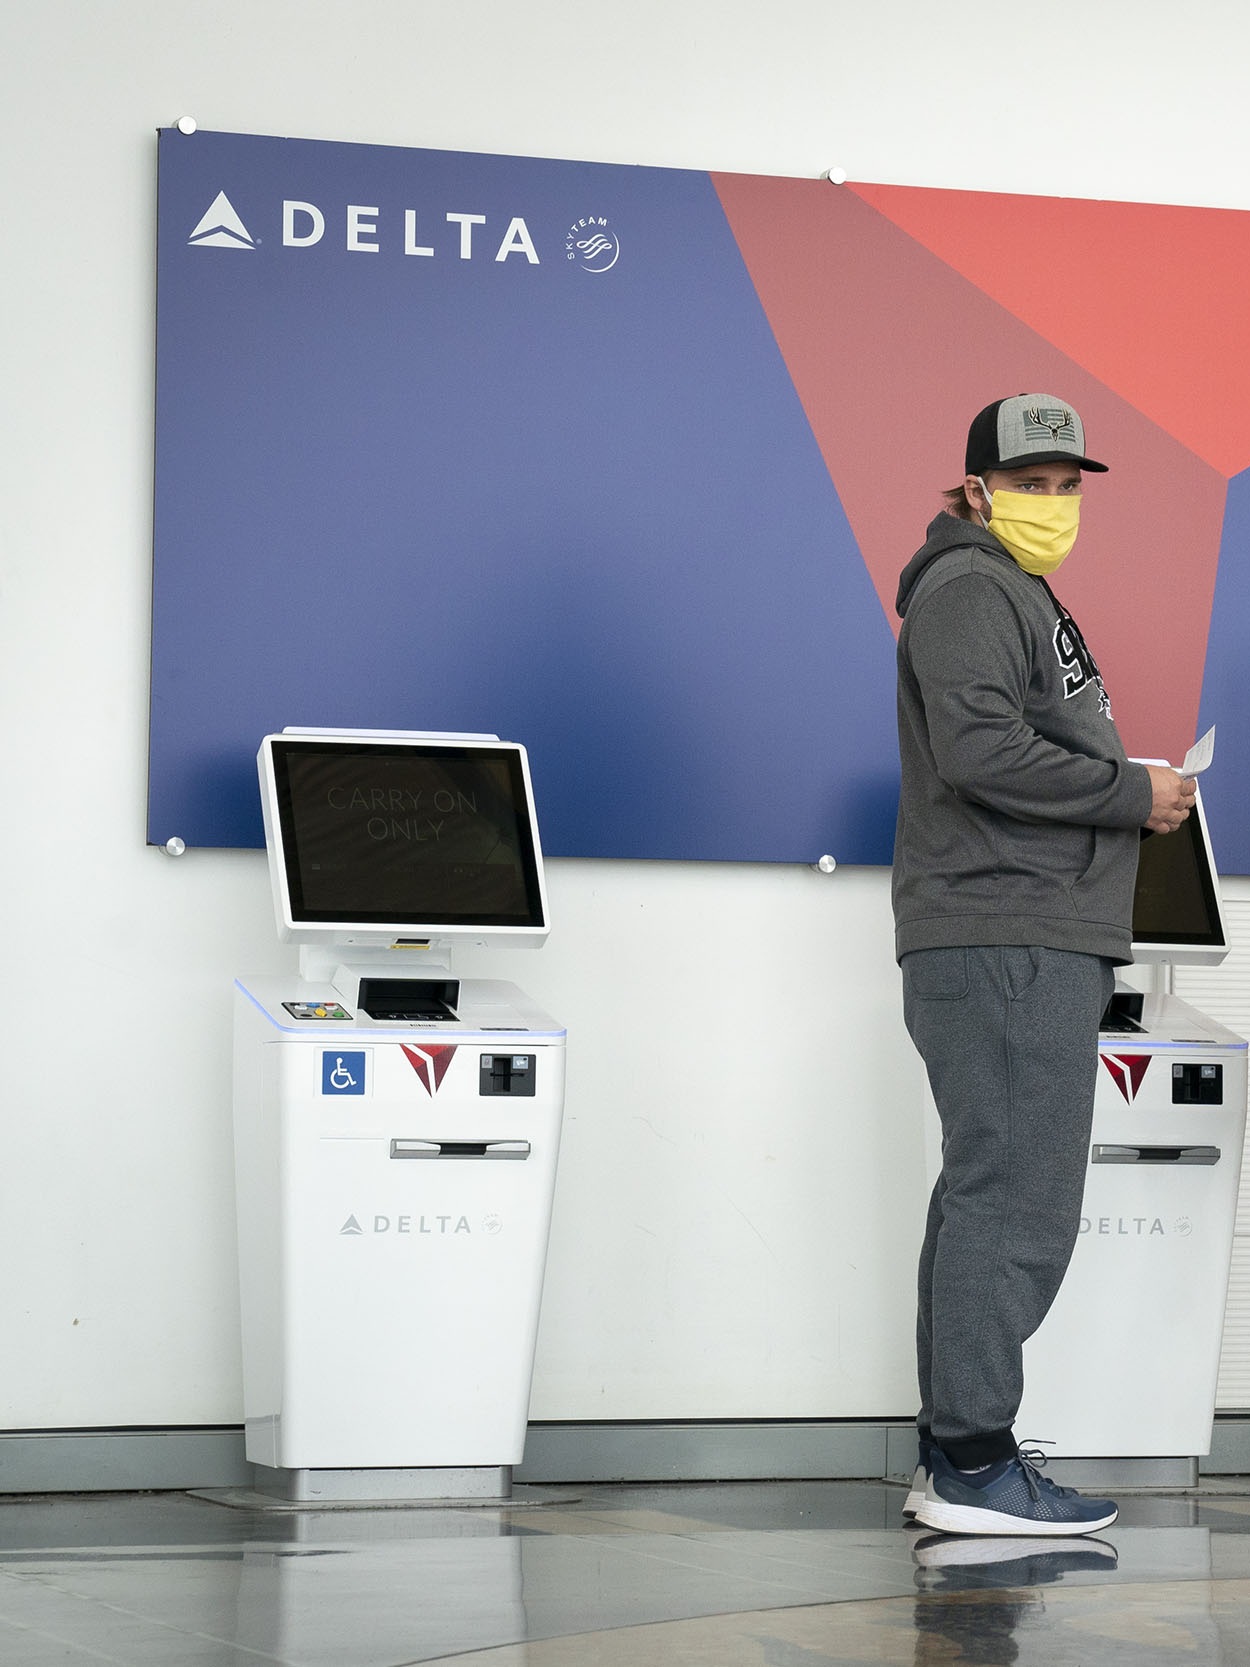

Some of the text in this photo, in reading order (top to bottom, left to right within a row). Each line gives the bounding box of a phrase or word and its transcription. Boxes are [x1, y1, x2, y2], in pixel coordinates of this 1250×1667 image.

[282, 200, 541, 265] DELTA
[565, 216, 608, 260] SKYTEAM
[327, 787, 478, 814] CARRY ON
[367, 816, 445, 841] ONLY
[374, 1215, 471, 1234] DELTA
[1079, 1217, 1165, 1235] DELTA
